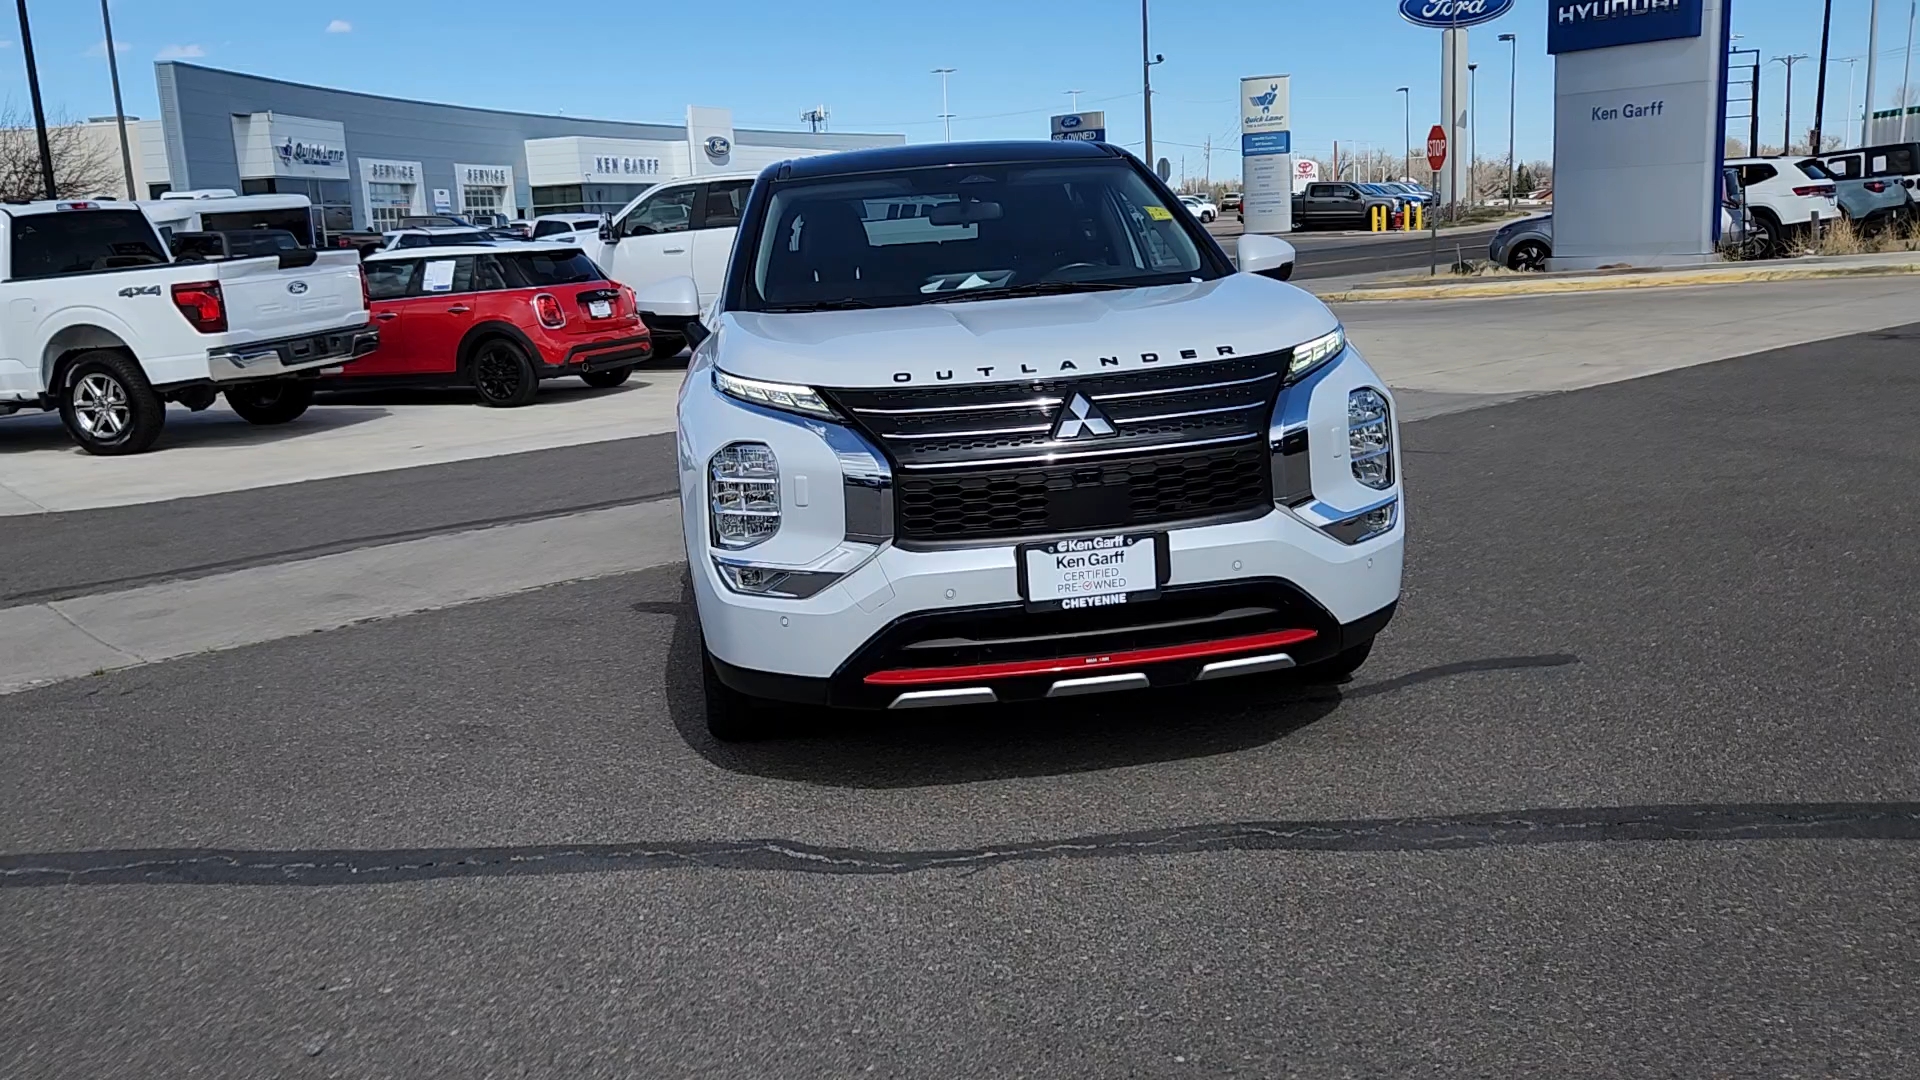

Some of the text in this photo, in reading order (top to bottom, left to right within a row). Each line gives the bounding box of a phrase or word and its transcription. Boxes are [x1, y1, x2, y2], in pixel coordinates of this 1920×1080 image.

[1422, 0, 1487, 17] Ford
[1559, 0, 1678, 25] HYUNDAI
[1592, 100, 1664, 121] Ken Garff
[1063, 118, 1078, 126] Ford
[1244, 116, 1263, 124] Quick
[1053, 131, 1096, 141] PRE-OWNED
[294, 142, 344, 161] Quick Lane
[1427, 139, 1446, 153] STOP
[372, 164, 414, 177] SERVICE
[596, 157, 659, 174] KEN GARFF
[467, 168, 506, 181] SERVICE
[893, 345, 1236, 383] OUTLANDER
[1068, 535, 1124, 552] Ken Garff
[1056, 551, 1124, 569] Ken Garff
[1064, 568, 1119, 581] CERTIFIED
[1062, 593, 1127, 610] CHEYENNE
